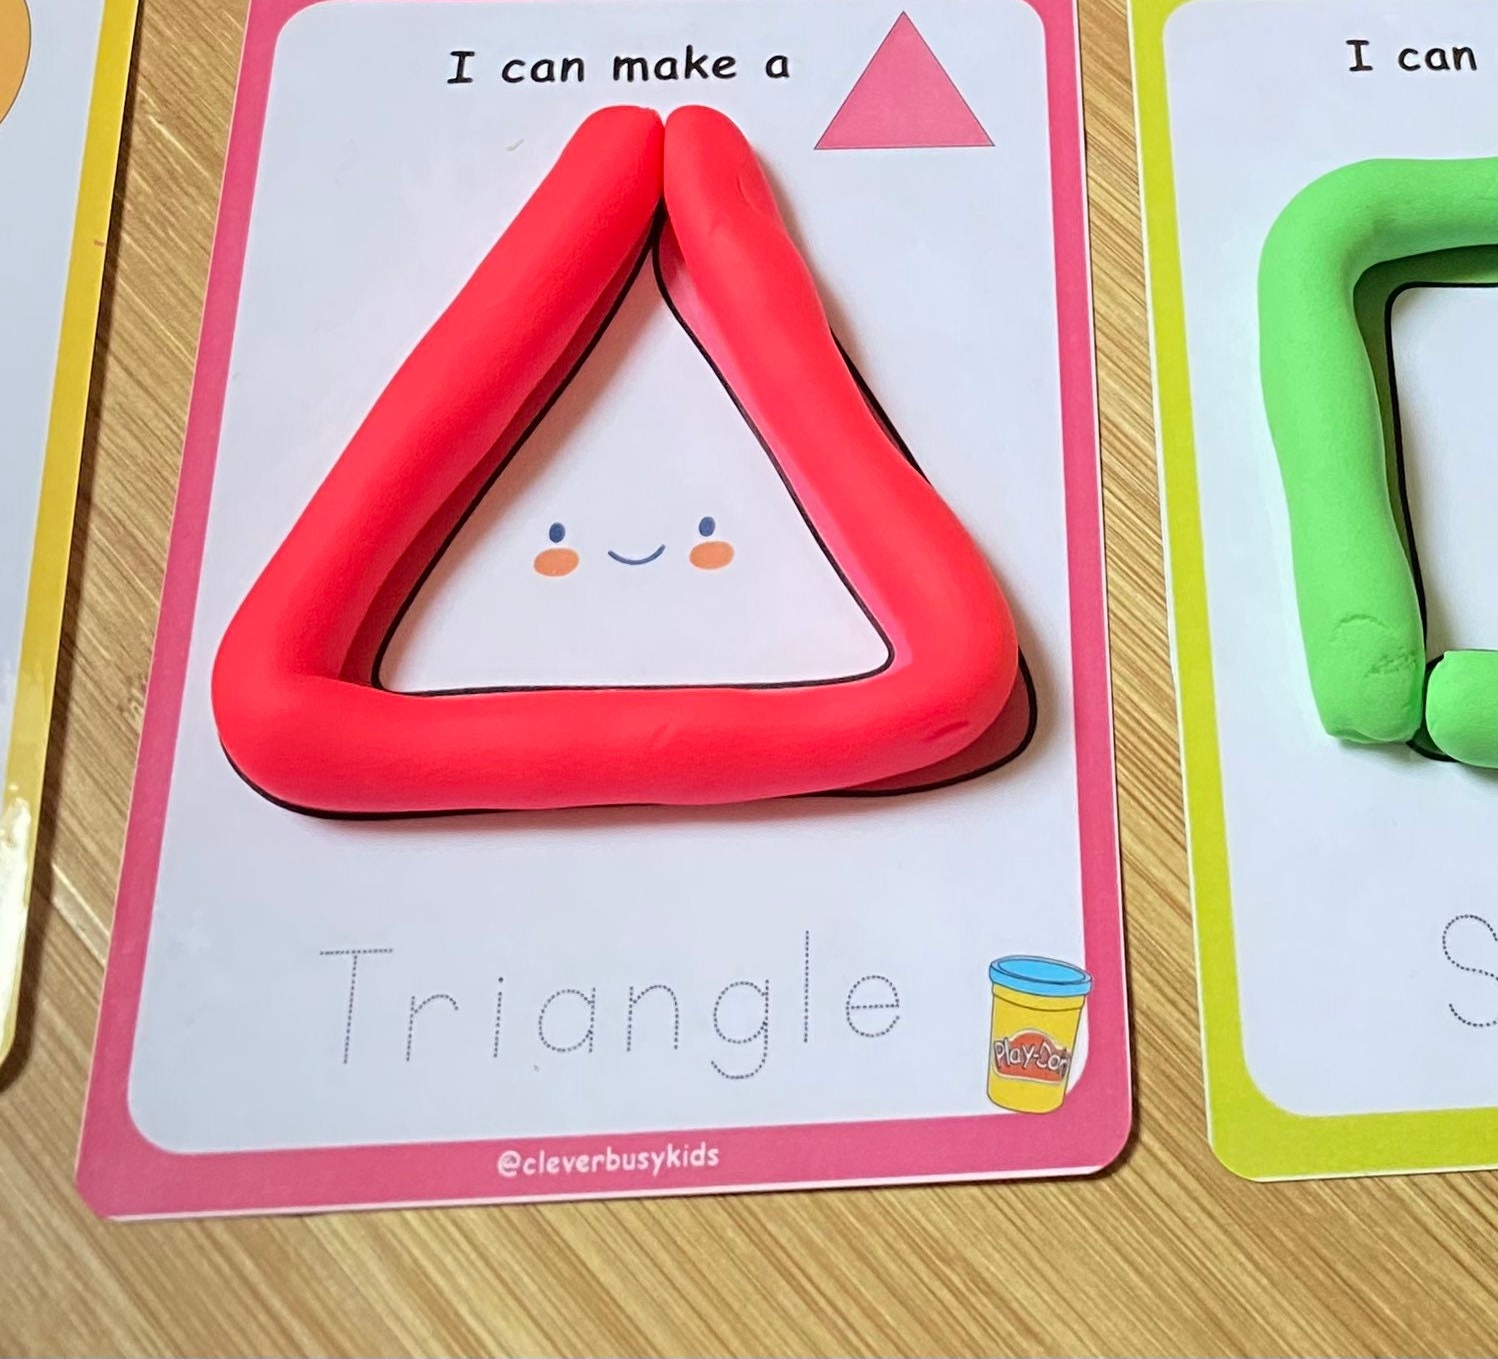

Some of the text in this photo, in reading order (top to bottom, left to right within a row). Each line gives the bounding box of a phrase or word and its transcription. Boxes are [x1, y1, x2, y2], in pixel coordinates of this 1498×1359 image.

[446, 44, 791, 85] I can make a
[1345, 39, 1374, 73] I
[1397, 46, 1478, 72] can
[318, 929, 902, 1082] Triangle
[496, 1140, 720, 1178] @cleverbusykids
